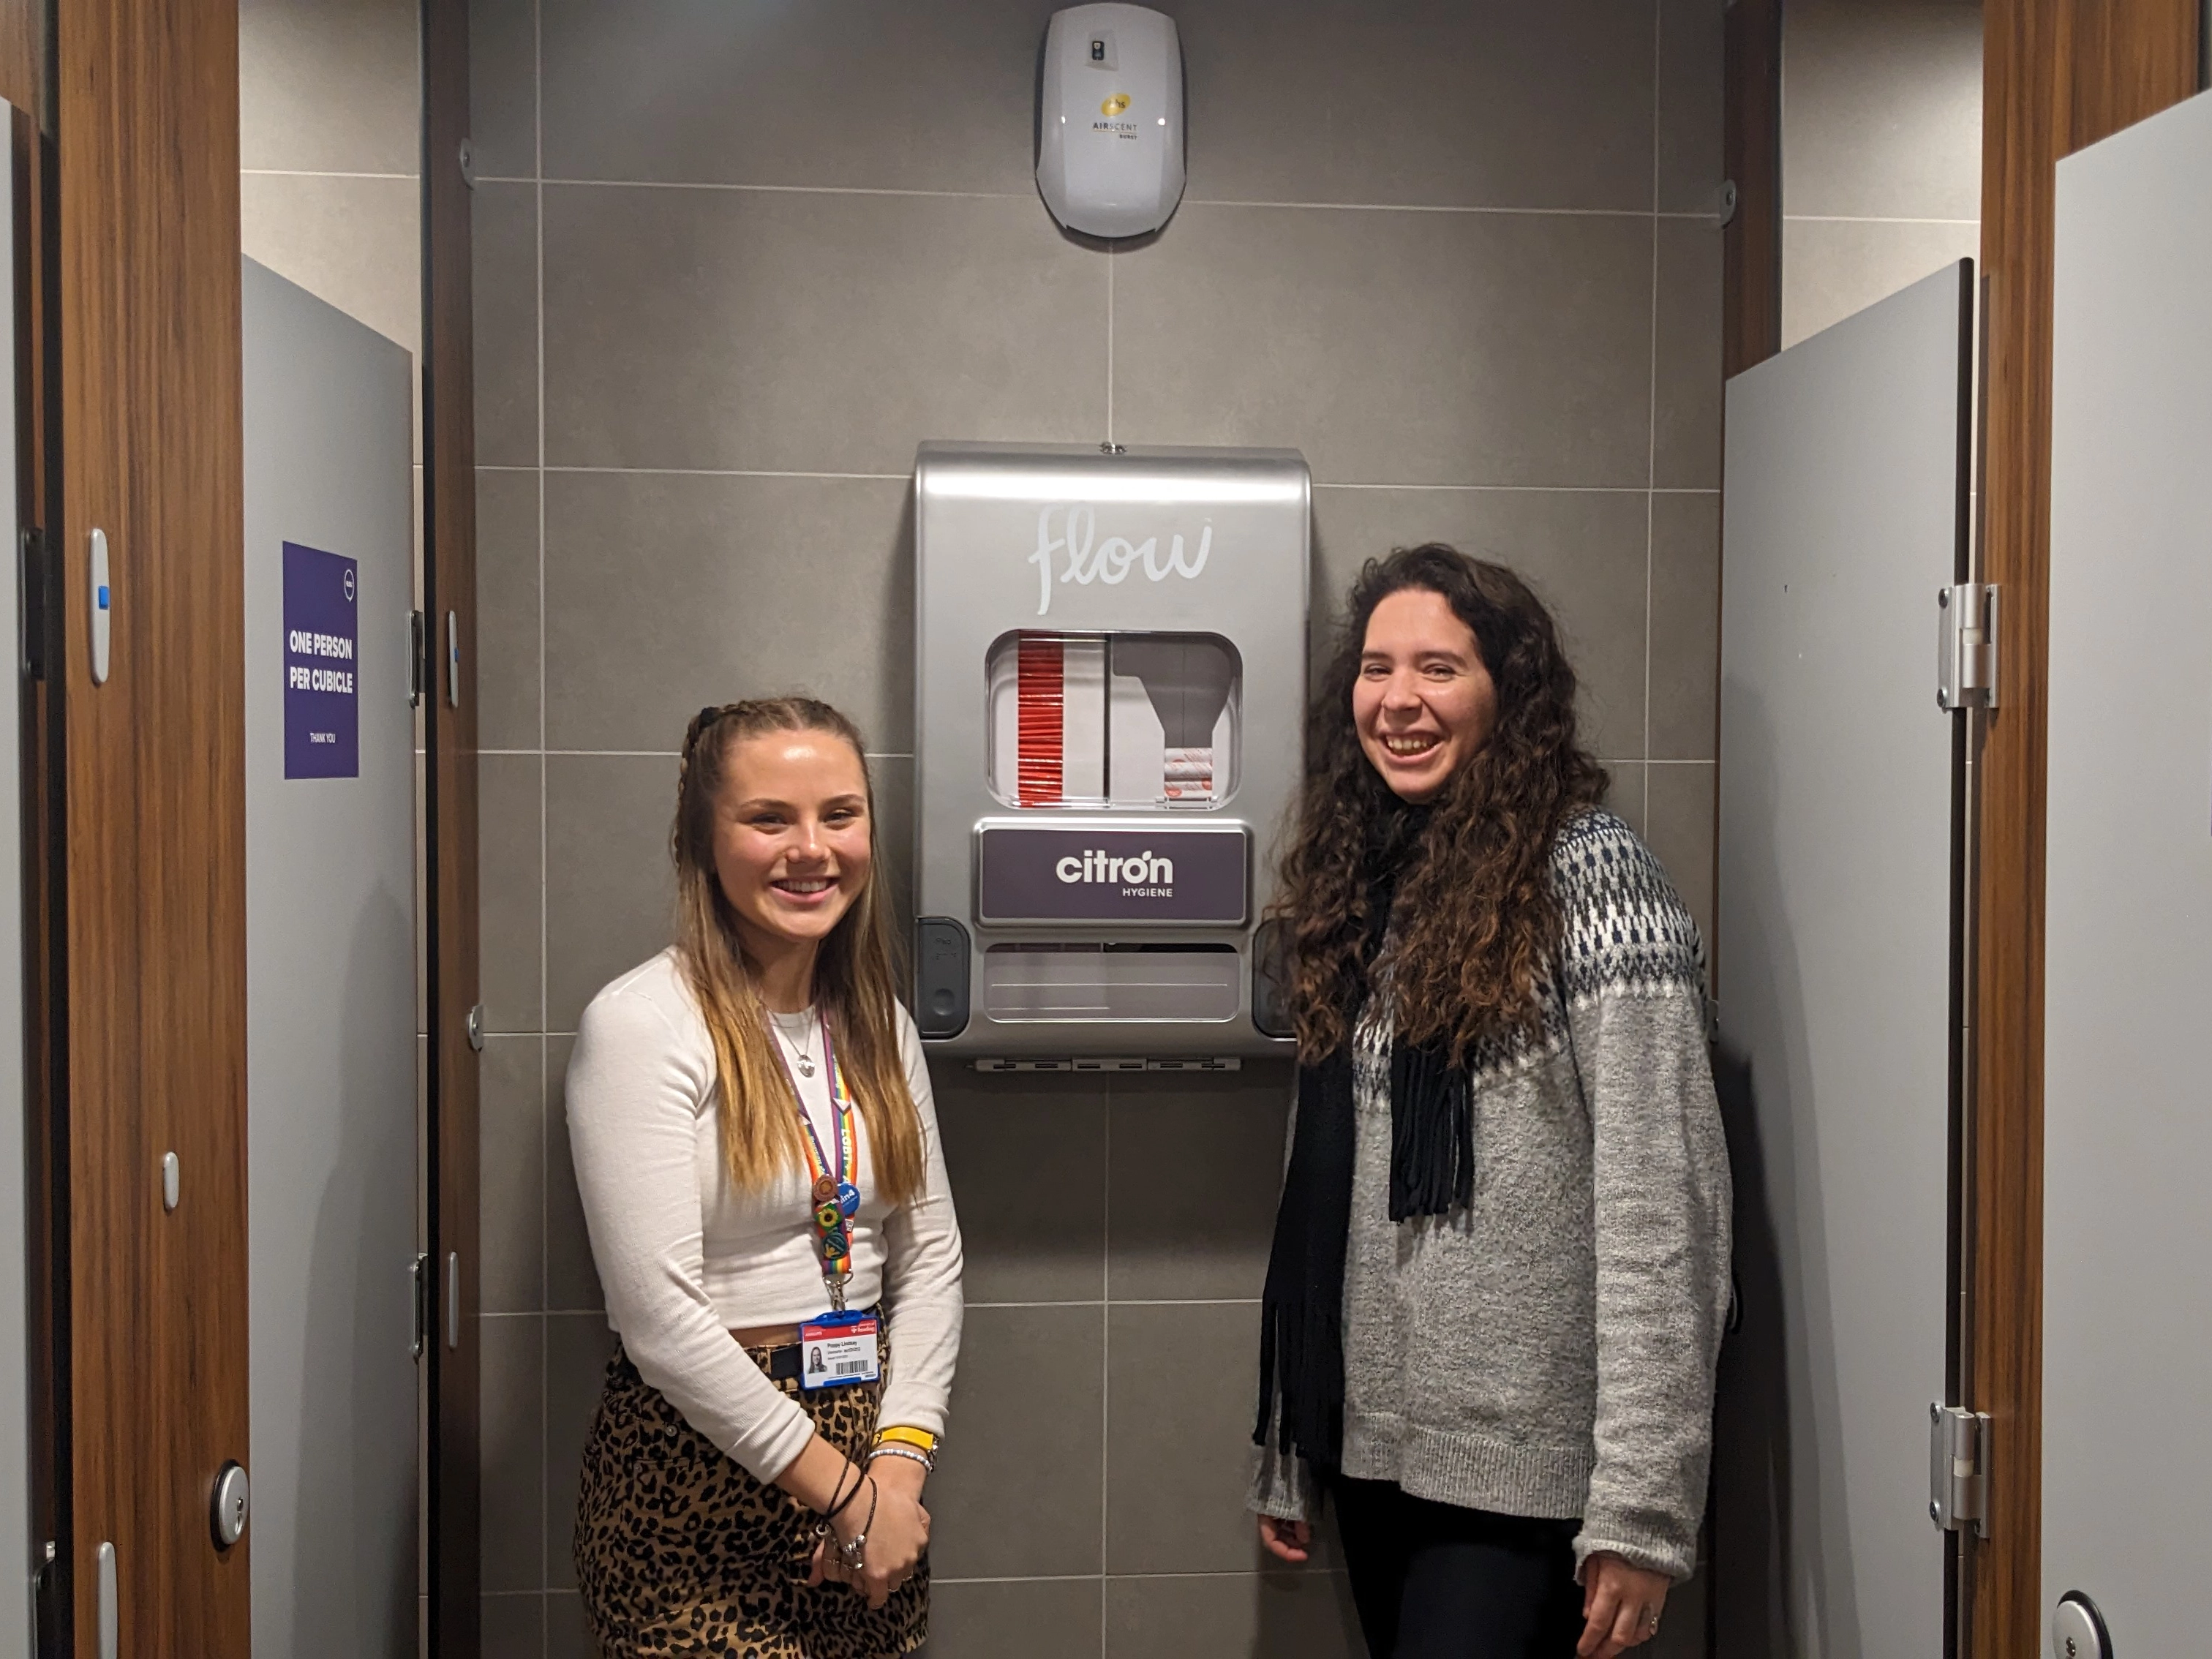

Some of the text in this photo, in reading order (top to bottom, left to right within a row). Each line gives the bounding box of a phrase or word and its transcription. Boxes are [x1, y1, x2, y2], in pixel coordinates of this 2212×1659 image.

[1093, 122, 1137, 131] AIRSCENT
[1028, 503, 1212, 615] flow
[290, 630, 353, 660] ONE PERSON
[290, 666, 353, 694] PER CUBICLE
[310, 732, 336, 744] THANK YOU
[1122, 887, 1173, 898] HYGIENE
